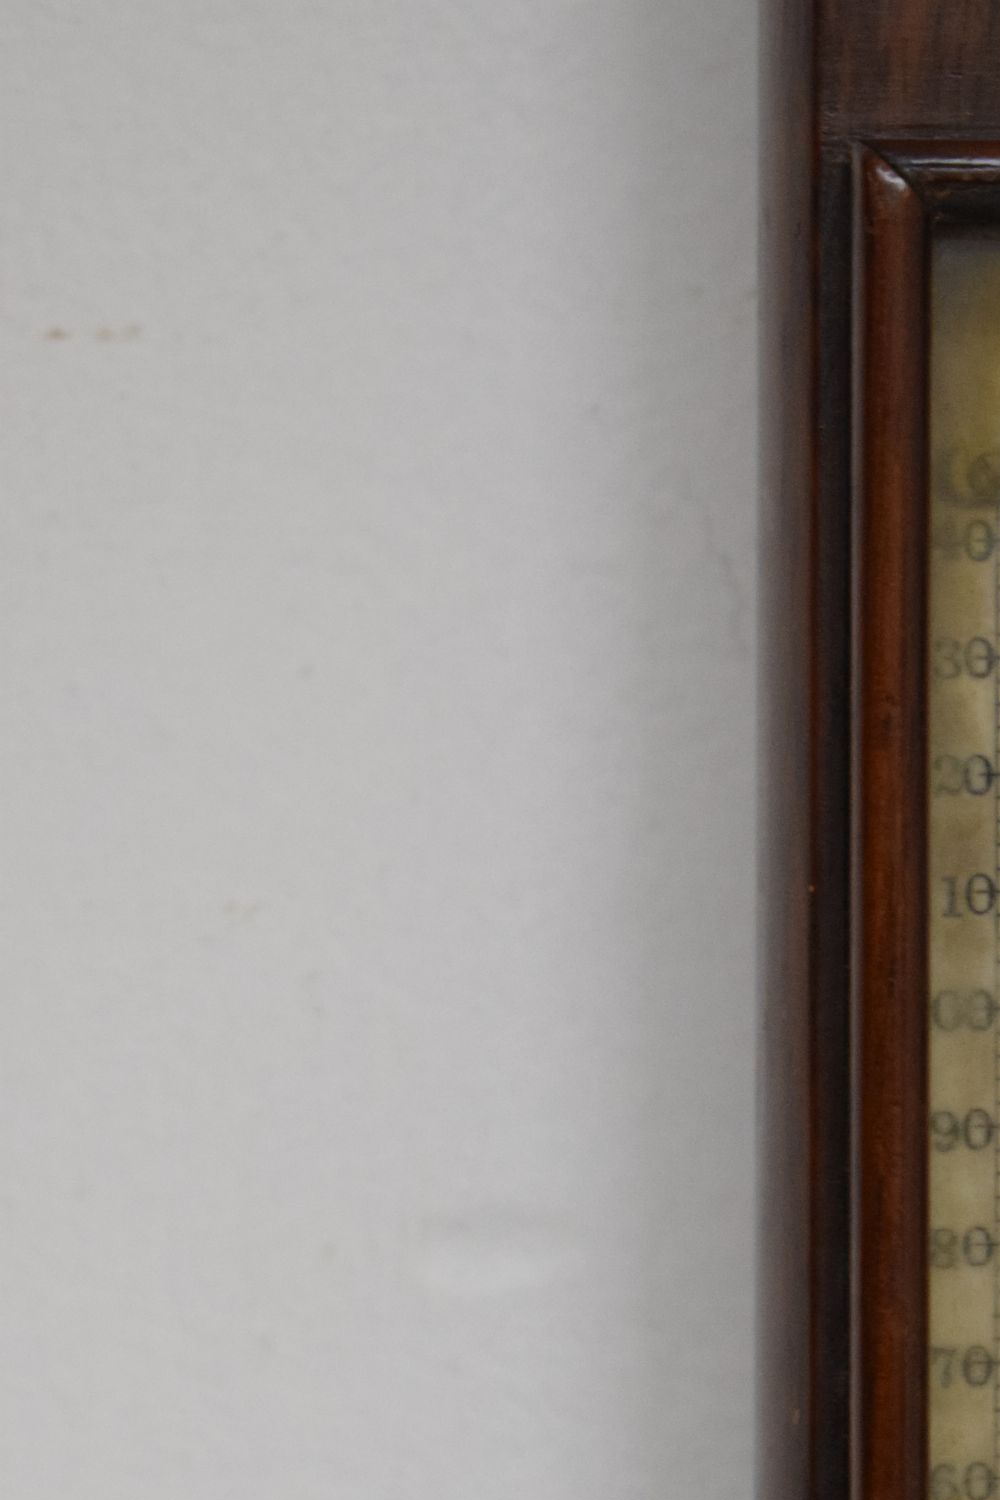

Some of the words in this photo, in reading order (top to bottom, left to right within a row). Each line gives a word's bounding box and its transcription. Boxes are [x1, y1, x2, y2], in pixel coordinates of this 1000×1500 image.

[935, 519, 994, 562] 0
[933, 636, 995, 679] 30
[934, 754, 995, 796] 20
[941, 873, 996, 918] 10
[930, 1107, 994, 1152] 90
[930, 1226, 994, 1269] 80
[930, 1345, 994, 1388] 70
